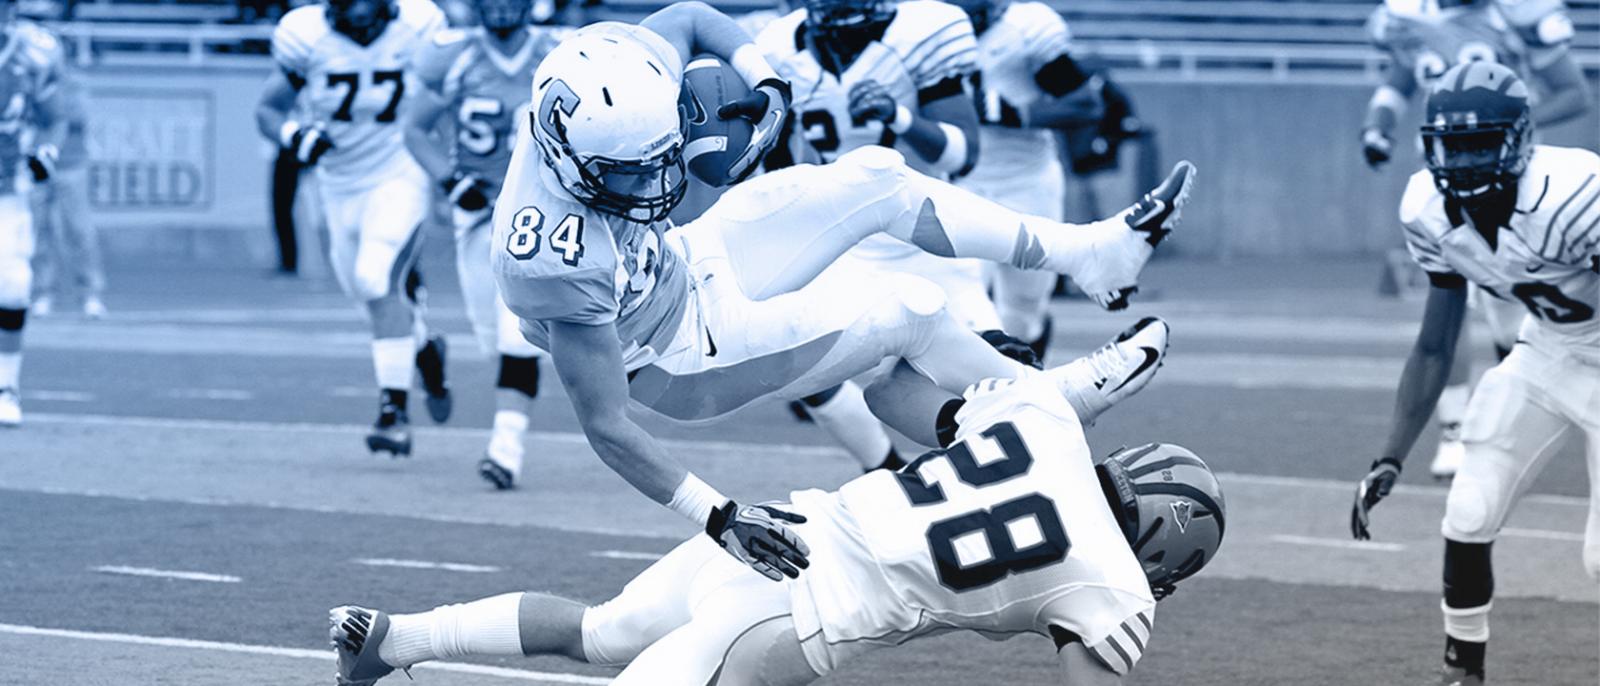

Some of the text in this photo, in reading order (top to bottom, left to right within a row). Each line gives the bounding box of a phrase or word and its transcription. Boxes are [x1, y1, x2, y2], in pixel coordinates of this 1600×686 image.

[327, 70, 405, 122] 77
[459, 97, 516, 155] 5
[87, 162, 203, 207] FIELD
[506, 206, 585, 267] 84
[1161, 470, 1174, 482] 28
[891, 421, 1072, 594] 28
